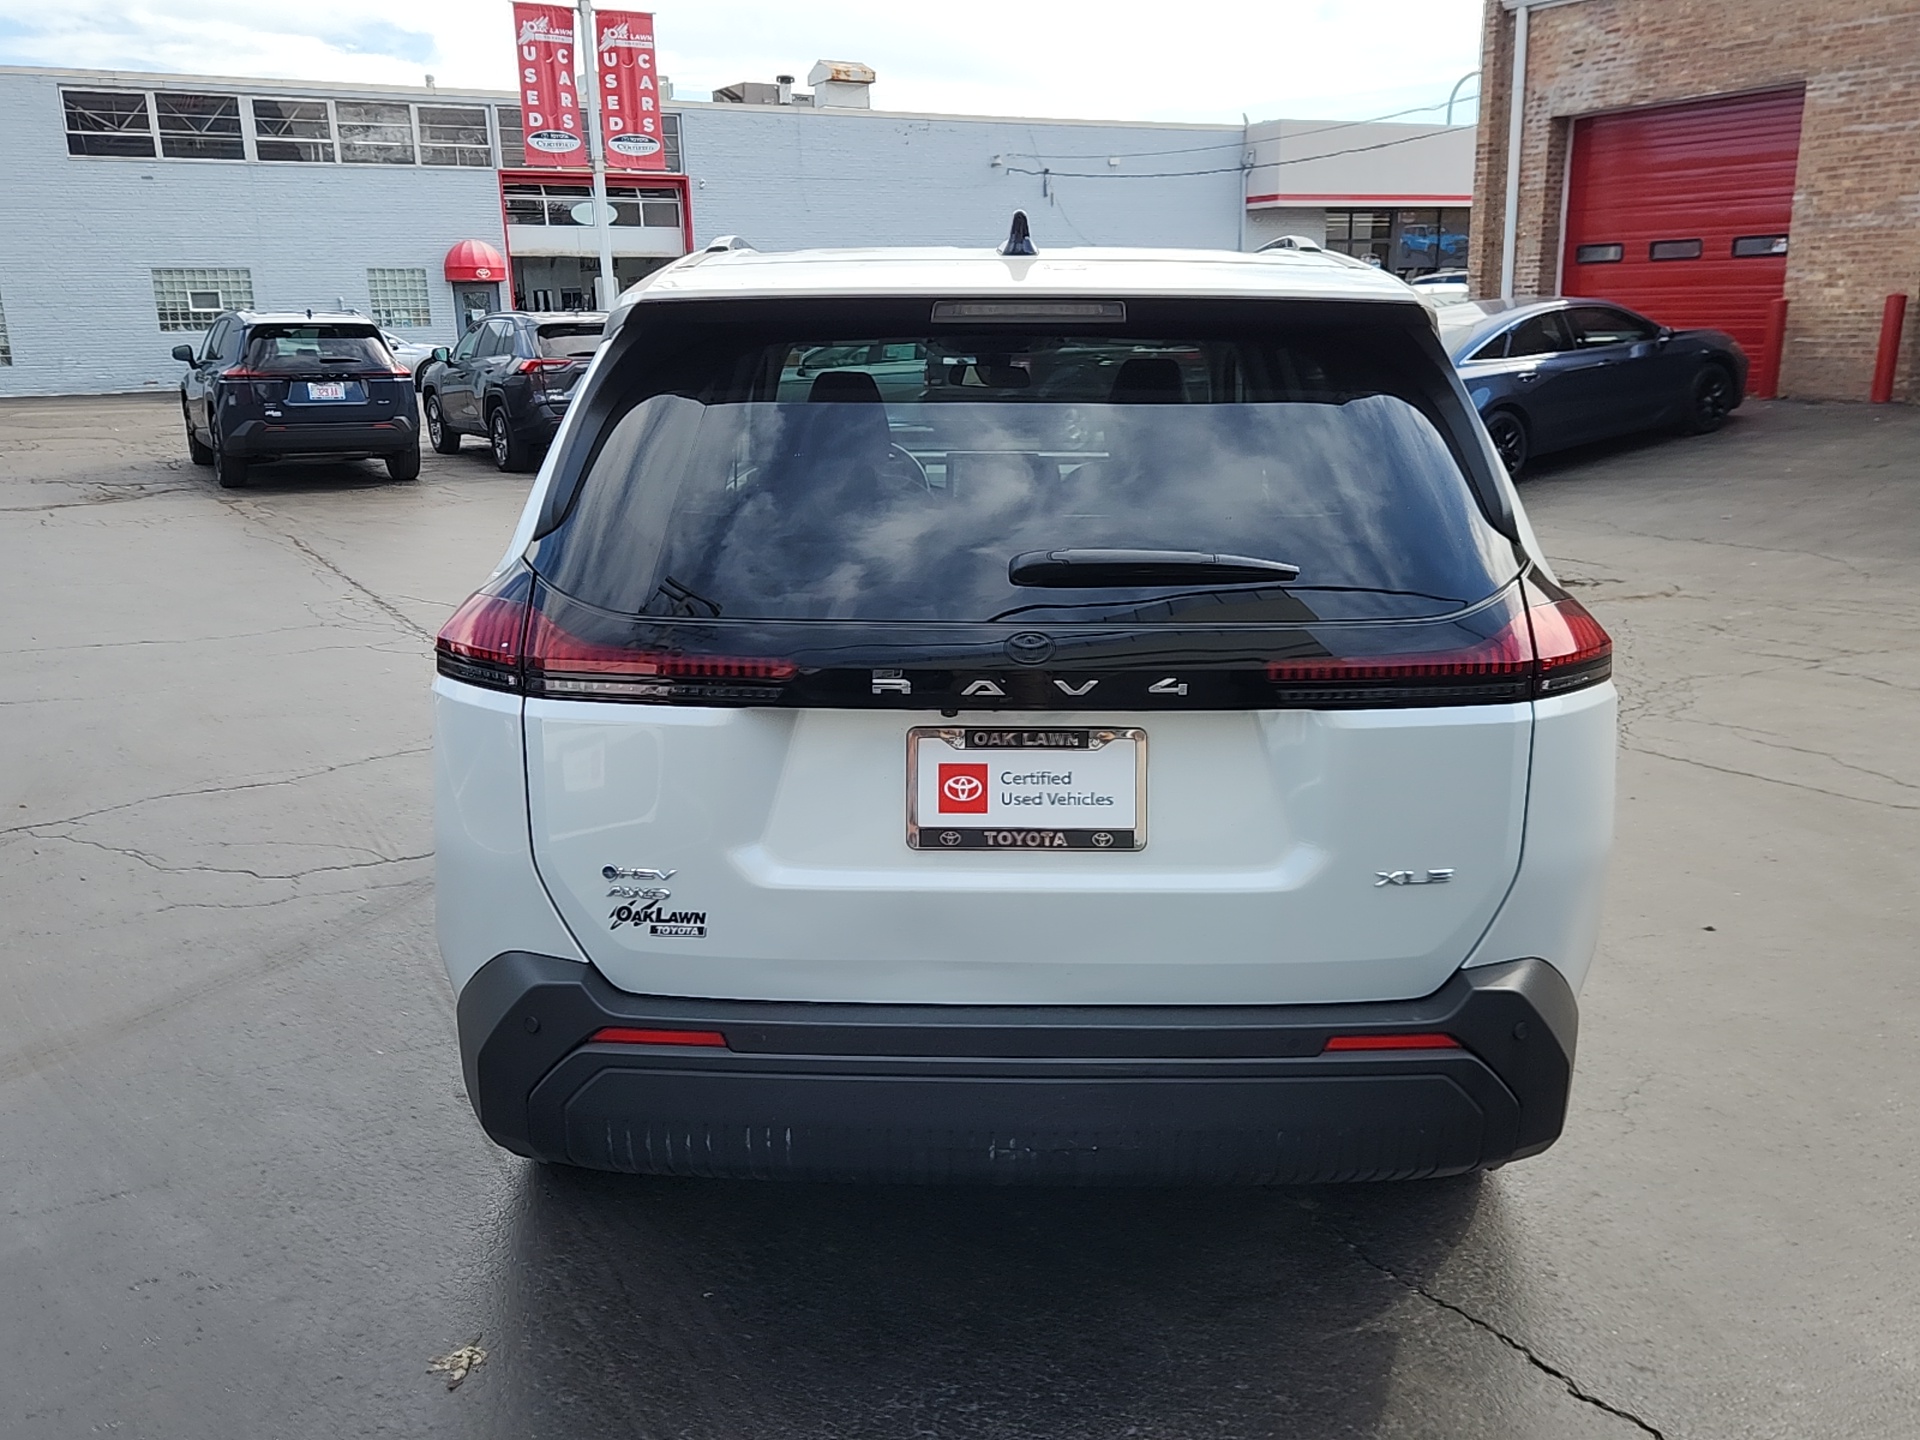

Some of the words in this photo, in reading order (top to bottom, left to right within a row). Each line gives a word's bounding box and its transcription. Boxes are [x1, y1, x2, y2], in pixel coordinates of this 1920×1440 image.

[549, 26, 573, 35] LAWN
[630, 33, 653, 41] LAWN
[522, 46, 543, 127] USED
[557, 49, 574, 129] CARS
[603, 52, 623, 131] USED
[637, 53, 655, 132] CARS
[871, 669, 1188, 697] RAV4
[973, 732, 1018, 746] OAK
[1021, 732, 1079, 746] LAWN
[1001, 771, 1072, 785] Certified
[1001, 792, 1043, 805] Used
[1046, 792, 1114, 805] Vehicles
[984, 831, 1068, 847] TOYOTA
[1374, 868, 1456, 887] XLE
[655, 926, 699, 936] TOYOTA
